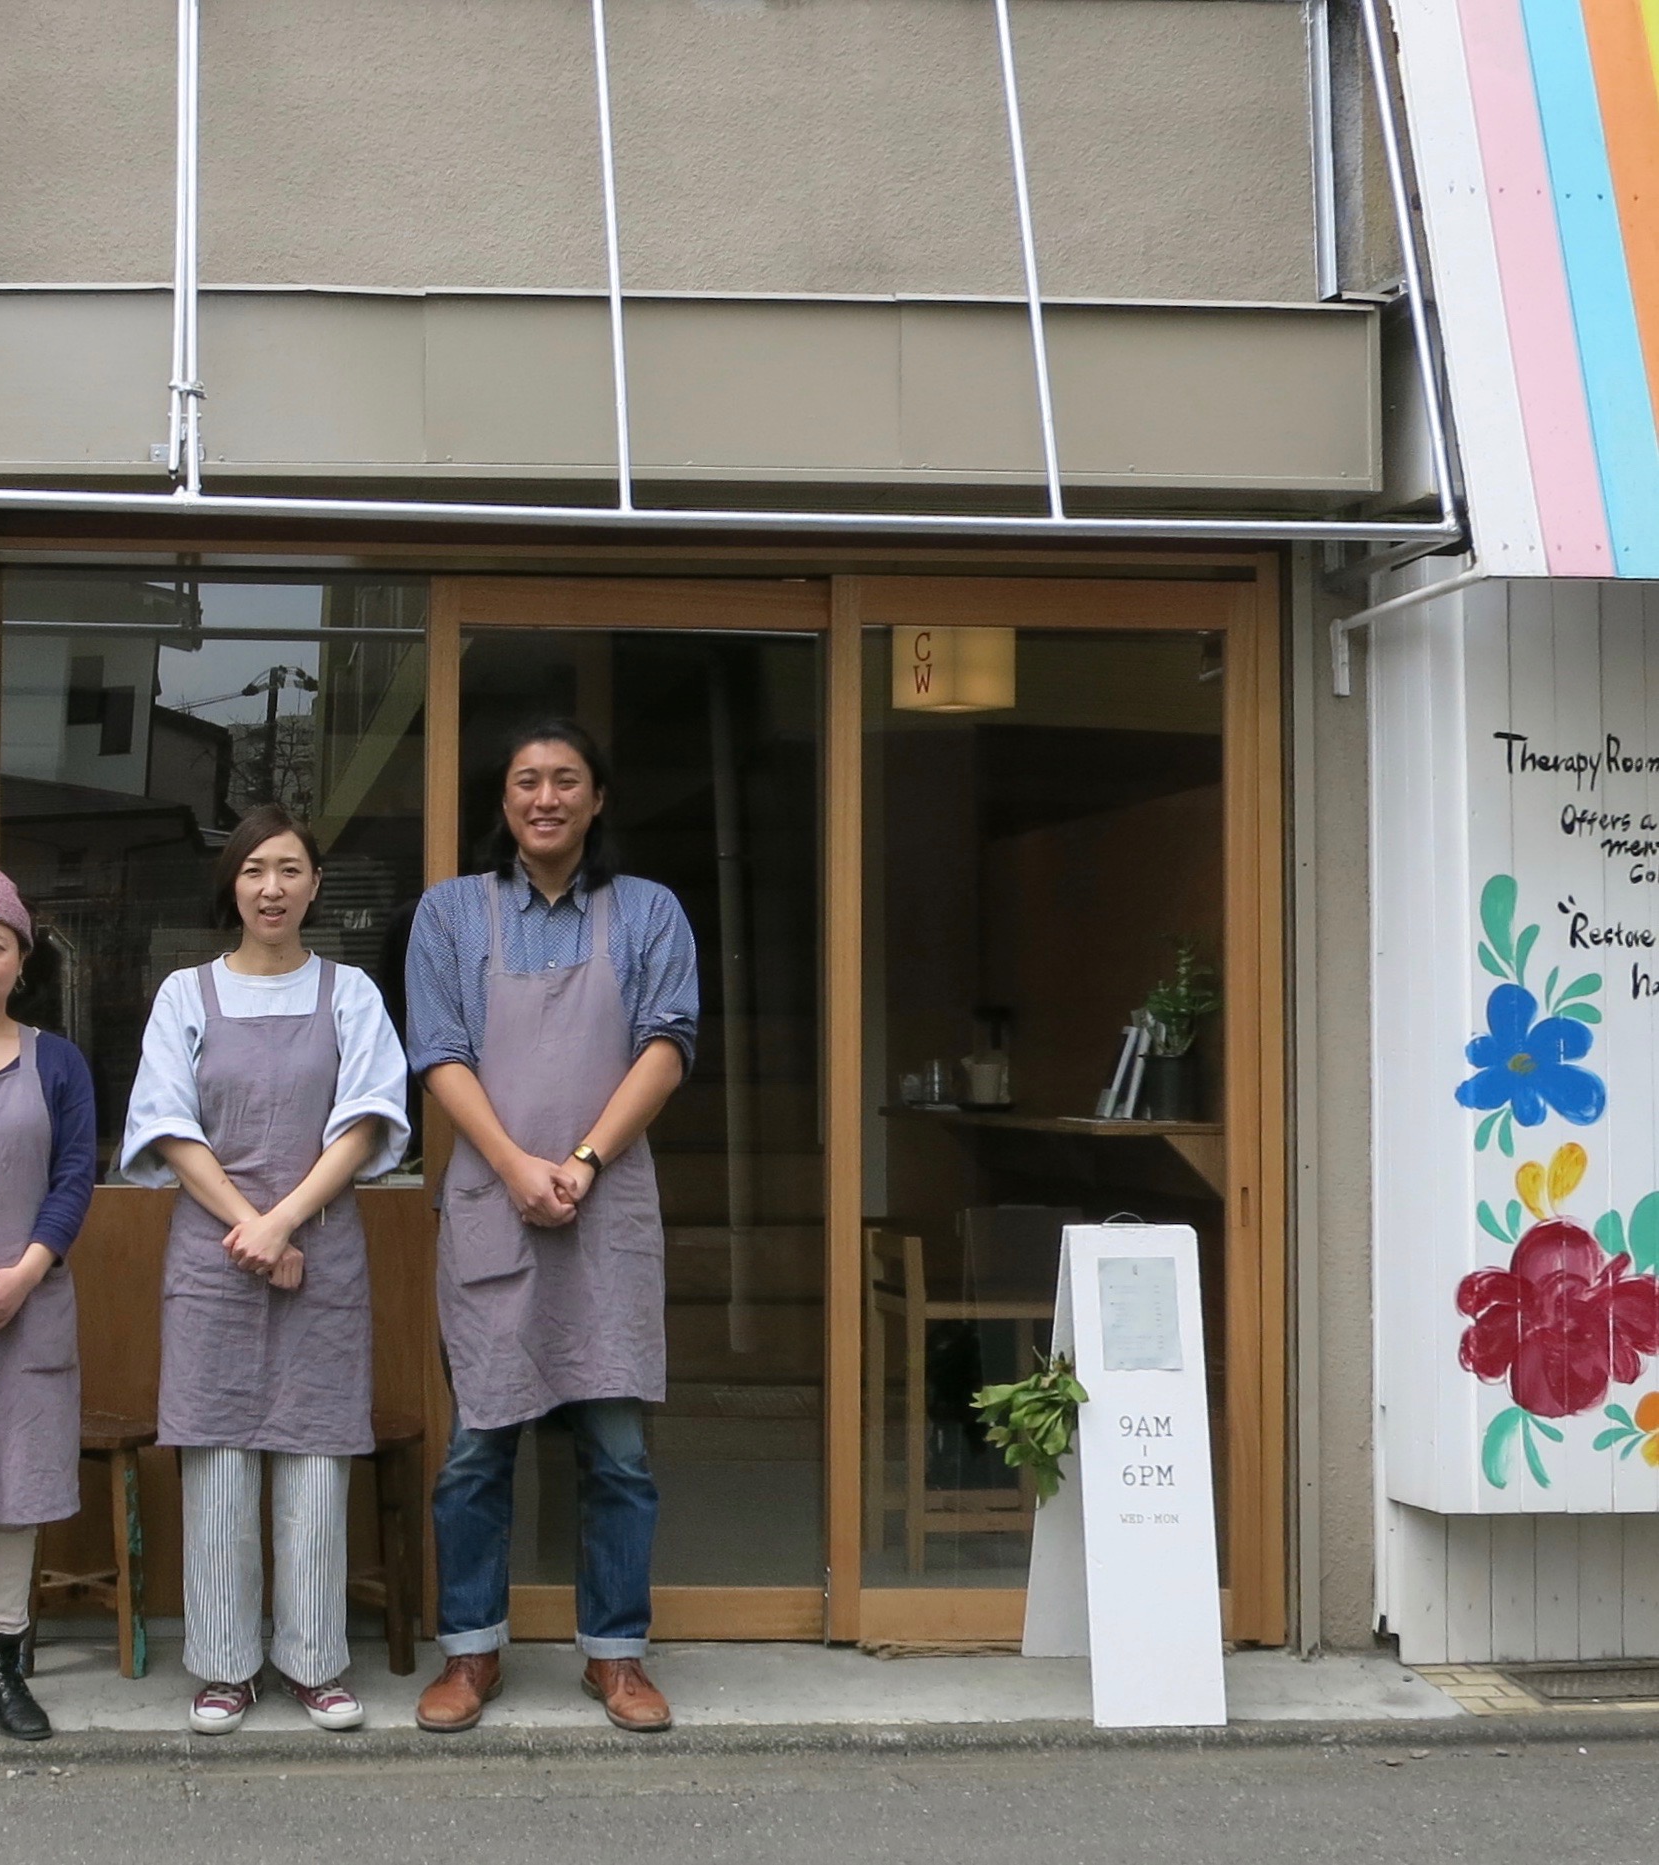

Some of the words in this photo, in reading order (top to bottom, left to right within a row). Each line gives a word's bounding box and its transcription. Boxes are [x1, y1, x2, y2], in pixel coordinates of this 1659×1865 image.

[1493, 731, 1602, 791] Therapy
[1560, 803, 1631, 837] Offers
[1640, 814, 1658, 831] a
[1601, 838, 1659, 858] men
[1629, 864, 1659, 884] Co
[1119, 1415, 1174, 1437] 9AM
[1122, 1464, 1176, 1487] 6PM
